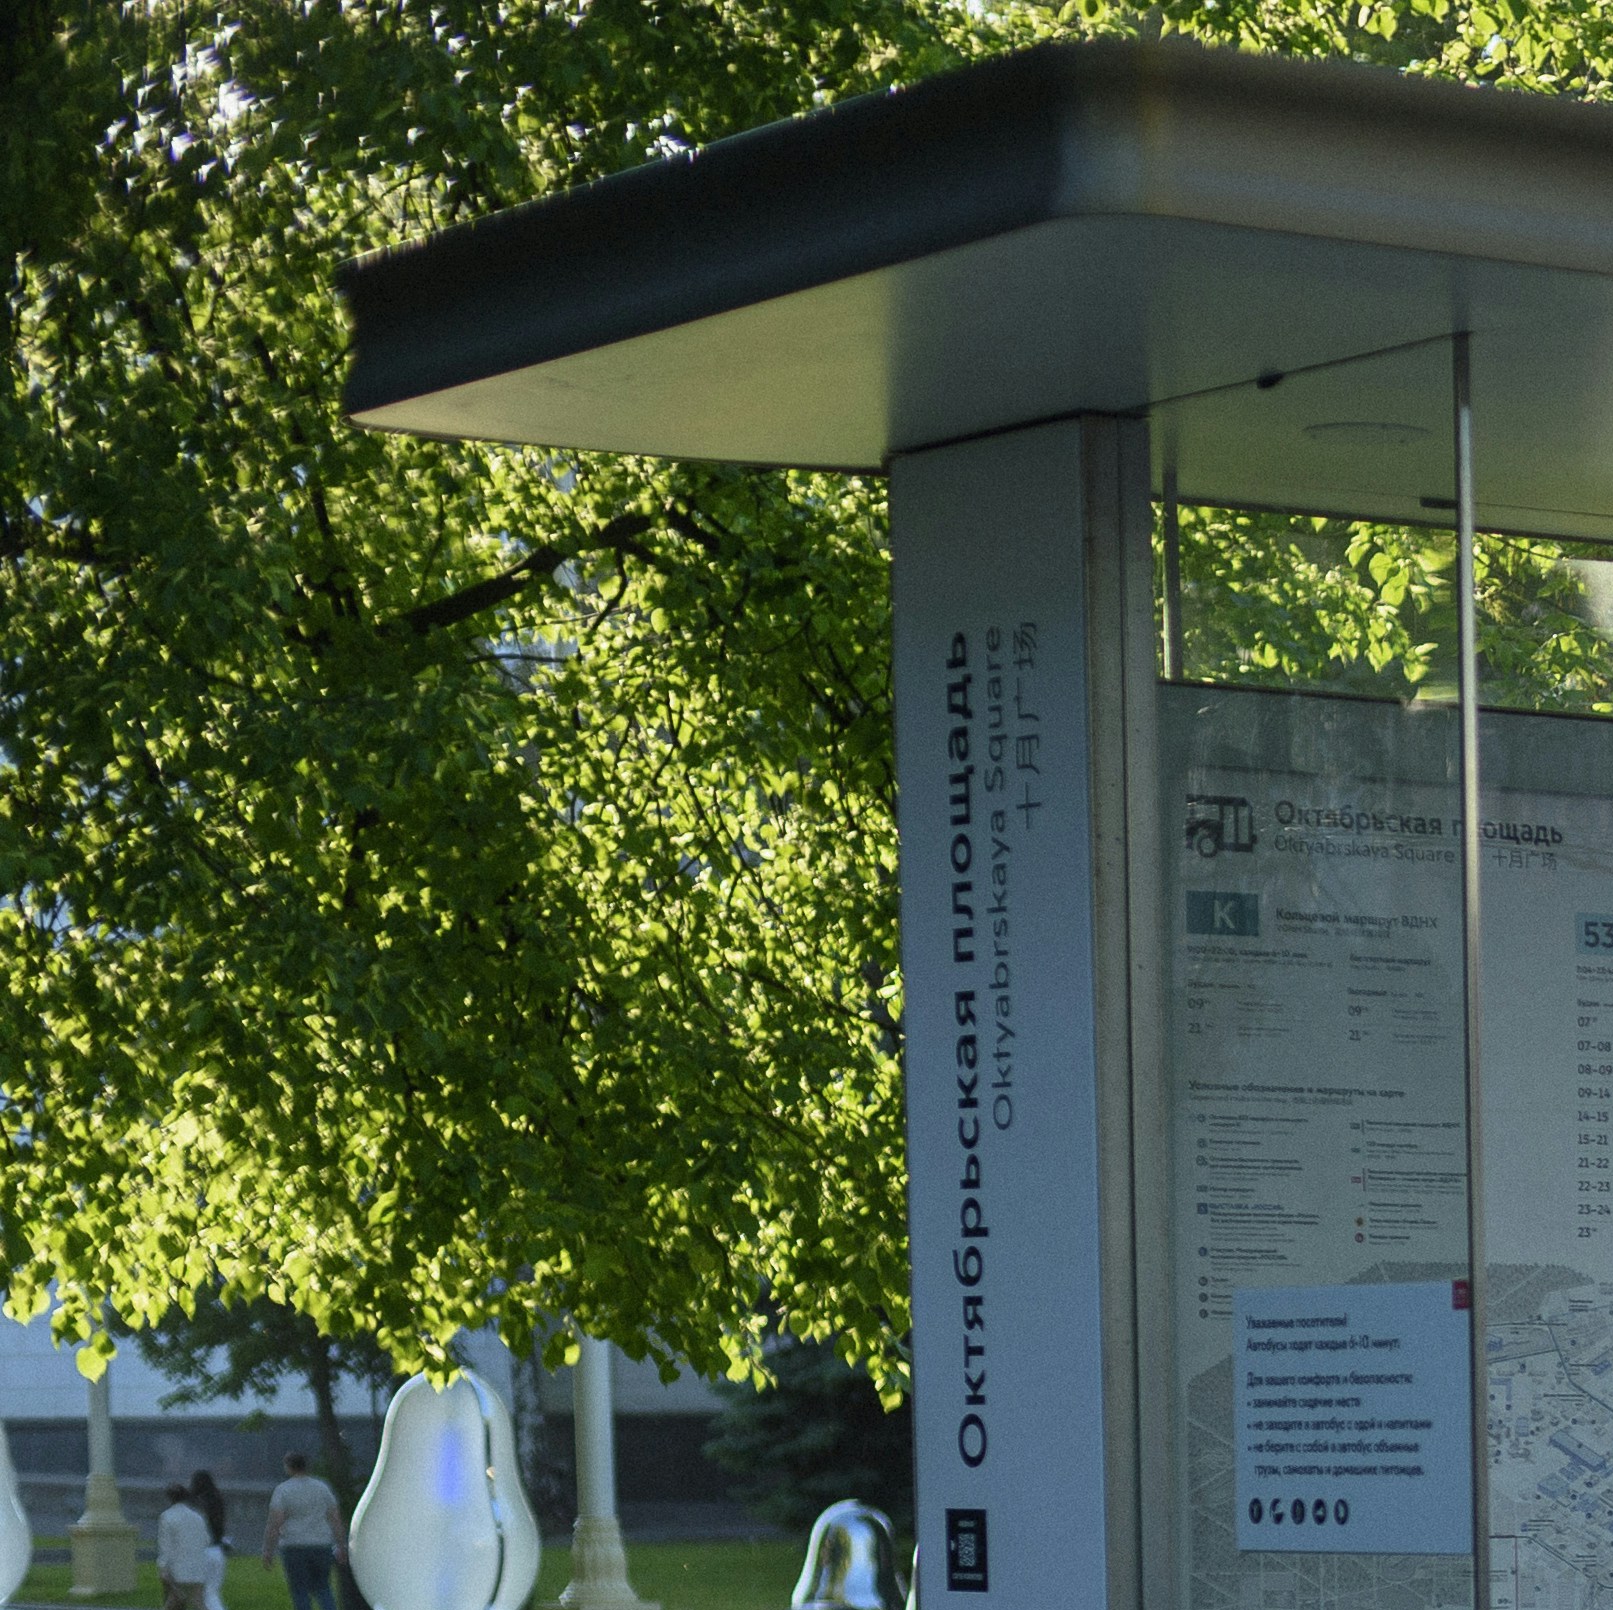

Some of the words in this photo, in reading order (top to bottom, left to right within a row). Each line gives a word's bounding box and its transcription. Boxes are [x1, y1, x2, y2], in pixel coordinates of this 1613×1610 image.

[946, 631, 975, 962] площадь
[981, 624, 1008, 792] Square
[1012, 619, 1043, 828] 十月广场
[1274, 800, 1442, 836] Октябрьская
[1452, 812, 1563, 848] пощадь
[1394, 843, 1454, 864] Square
[986, 809, 1016, 1130] Oktyabrskaya
[1275, 907, 1340, 924] Кольцевой
[1342, 915, 1399, 932] маршрут
[1401, 915, 1437, 929] ВДНХ
[953, 985, 991, 1467] Октябрьская
